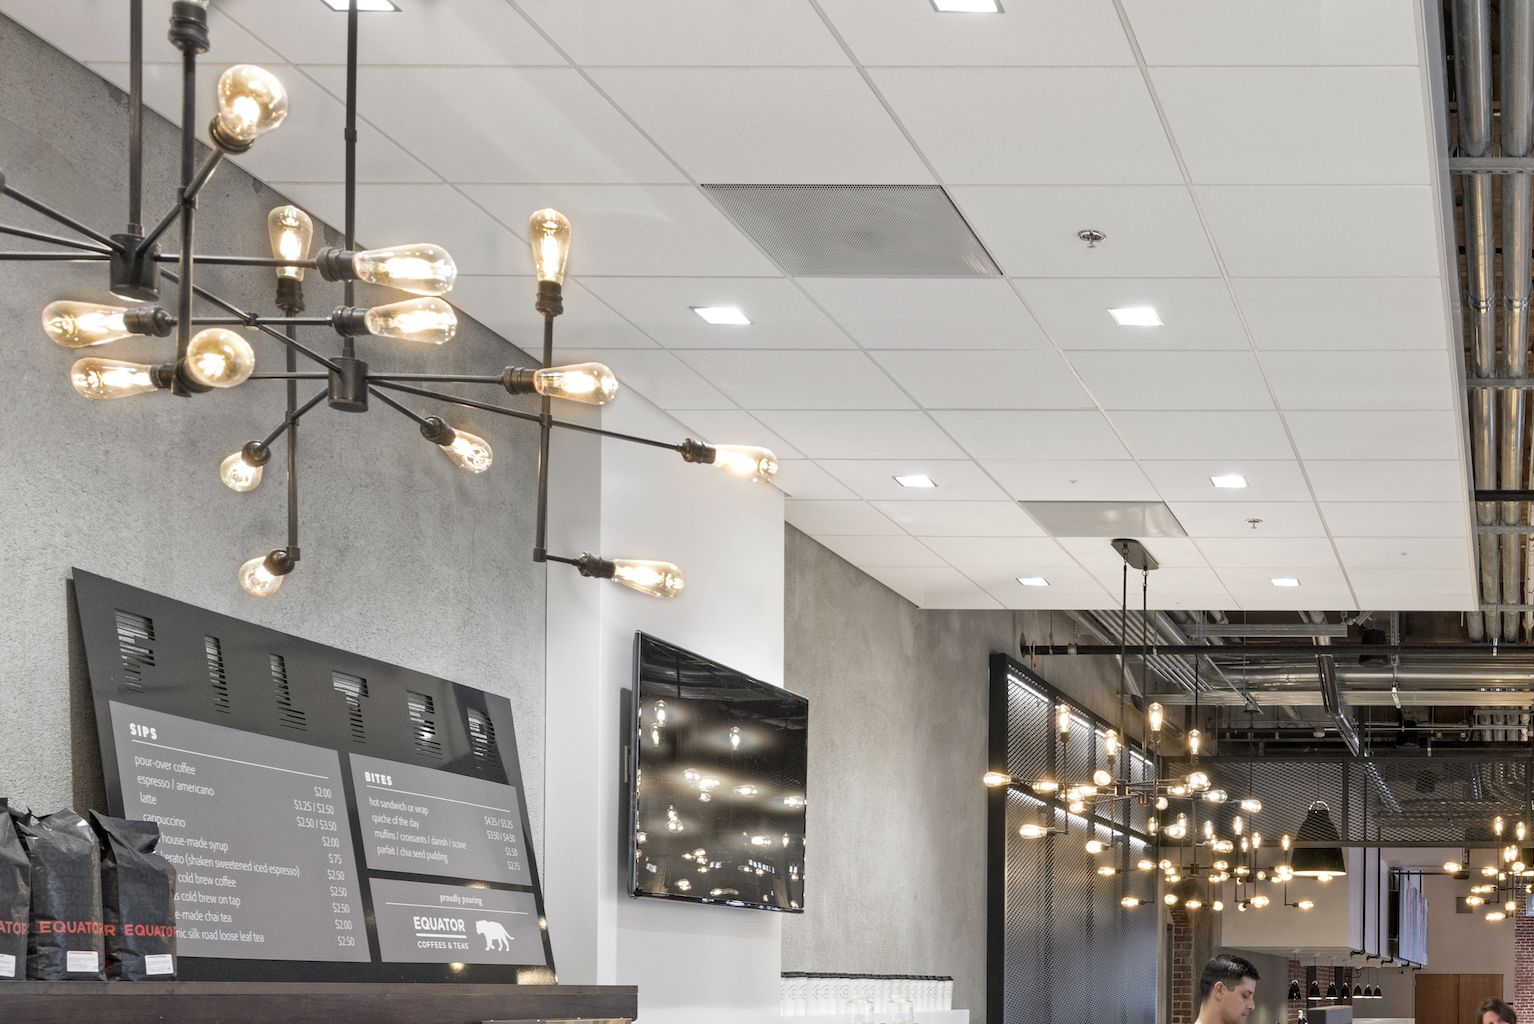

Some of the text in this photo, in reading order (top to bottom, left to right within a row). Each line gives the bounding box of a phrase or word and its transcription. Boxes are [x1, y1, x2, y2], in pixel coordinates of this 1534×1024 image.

[129, 723, 157, 740] SIPS
[134, 756, 196, 775] pour-over coffee
[137, 775, 170, 788] espresso
[176, 782, 214, 796] americano
[364, 771, 392, 786] BITES
[140, 791, 157, 805] latte
[314, 786, 332, 798] $2.00
[294, 799, 312, 812] $1.25
[316, 802, 334, 815] $2.50
[368, 796, 428, 816] hot sandwich or wrap
[296, 816, 314, 829] $2.50
[319, 819, 337, 832] $3.50
[372, 814, 420, 830] quiche of the day
[162, 832, 228, 854] house-made syrup
[322, 836, 340, 848] $2.00
[374, 829, 396, 840] muffins
[400, 833, 428, 844] croissants
[430, 836, 448, 847] danish
[452, 841, 467, 850] scone
[377, 844, 396, 856] parfait
[400, 847, 412, 857] chia
[412, 849, 426, 858] seed
[426, 850, 449, 864] pudding
[185, 853, 214, 867] (shaken
[215, 858, 252, 872] sweetened
[254, 862, 268, 873] iced
[268, 866, 300, 878] espresso)
[178, 873, 236, 888] cold brew coffee
[327, 869, 344, 881] $2.50
[181, 890, 198, 902] cold
[198, 892, 217, 904] brew
[218, 896, 228, 904] on
[228, 895, 240, 908] tap
[330, 886, 347, 897] $2.50
[440, 894, 483, 906] proudly pouring
[332, 902, 350, 914] $2.50
[204, 911, 220, 922] chai
[220, 912, 232, 923] tea
[335, 919, 352, 930] $2.00
[413, 916, 466, 932] EQUATOR
[188, 928, 201, 940] silk
[202, 929, 218, 940] road
[219, 930, 239, 941] loose
[240, 931, 252, 942] leaf
[252, 932, 264, 943] tea
[337, 935, 355, 947] $2.50
[418, 940, 470, 950] COFFEES & TEAS
